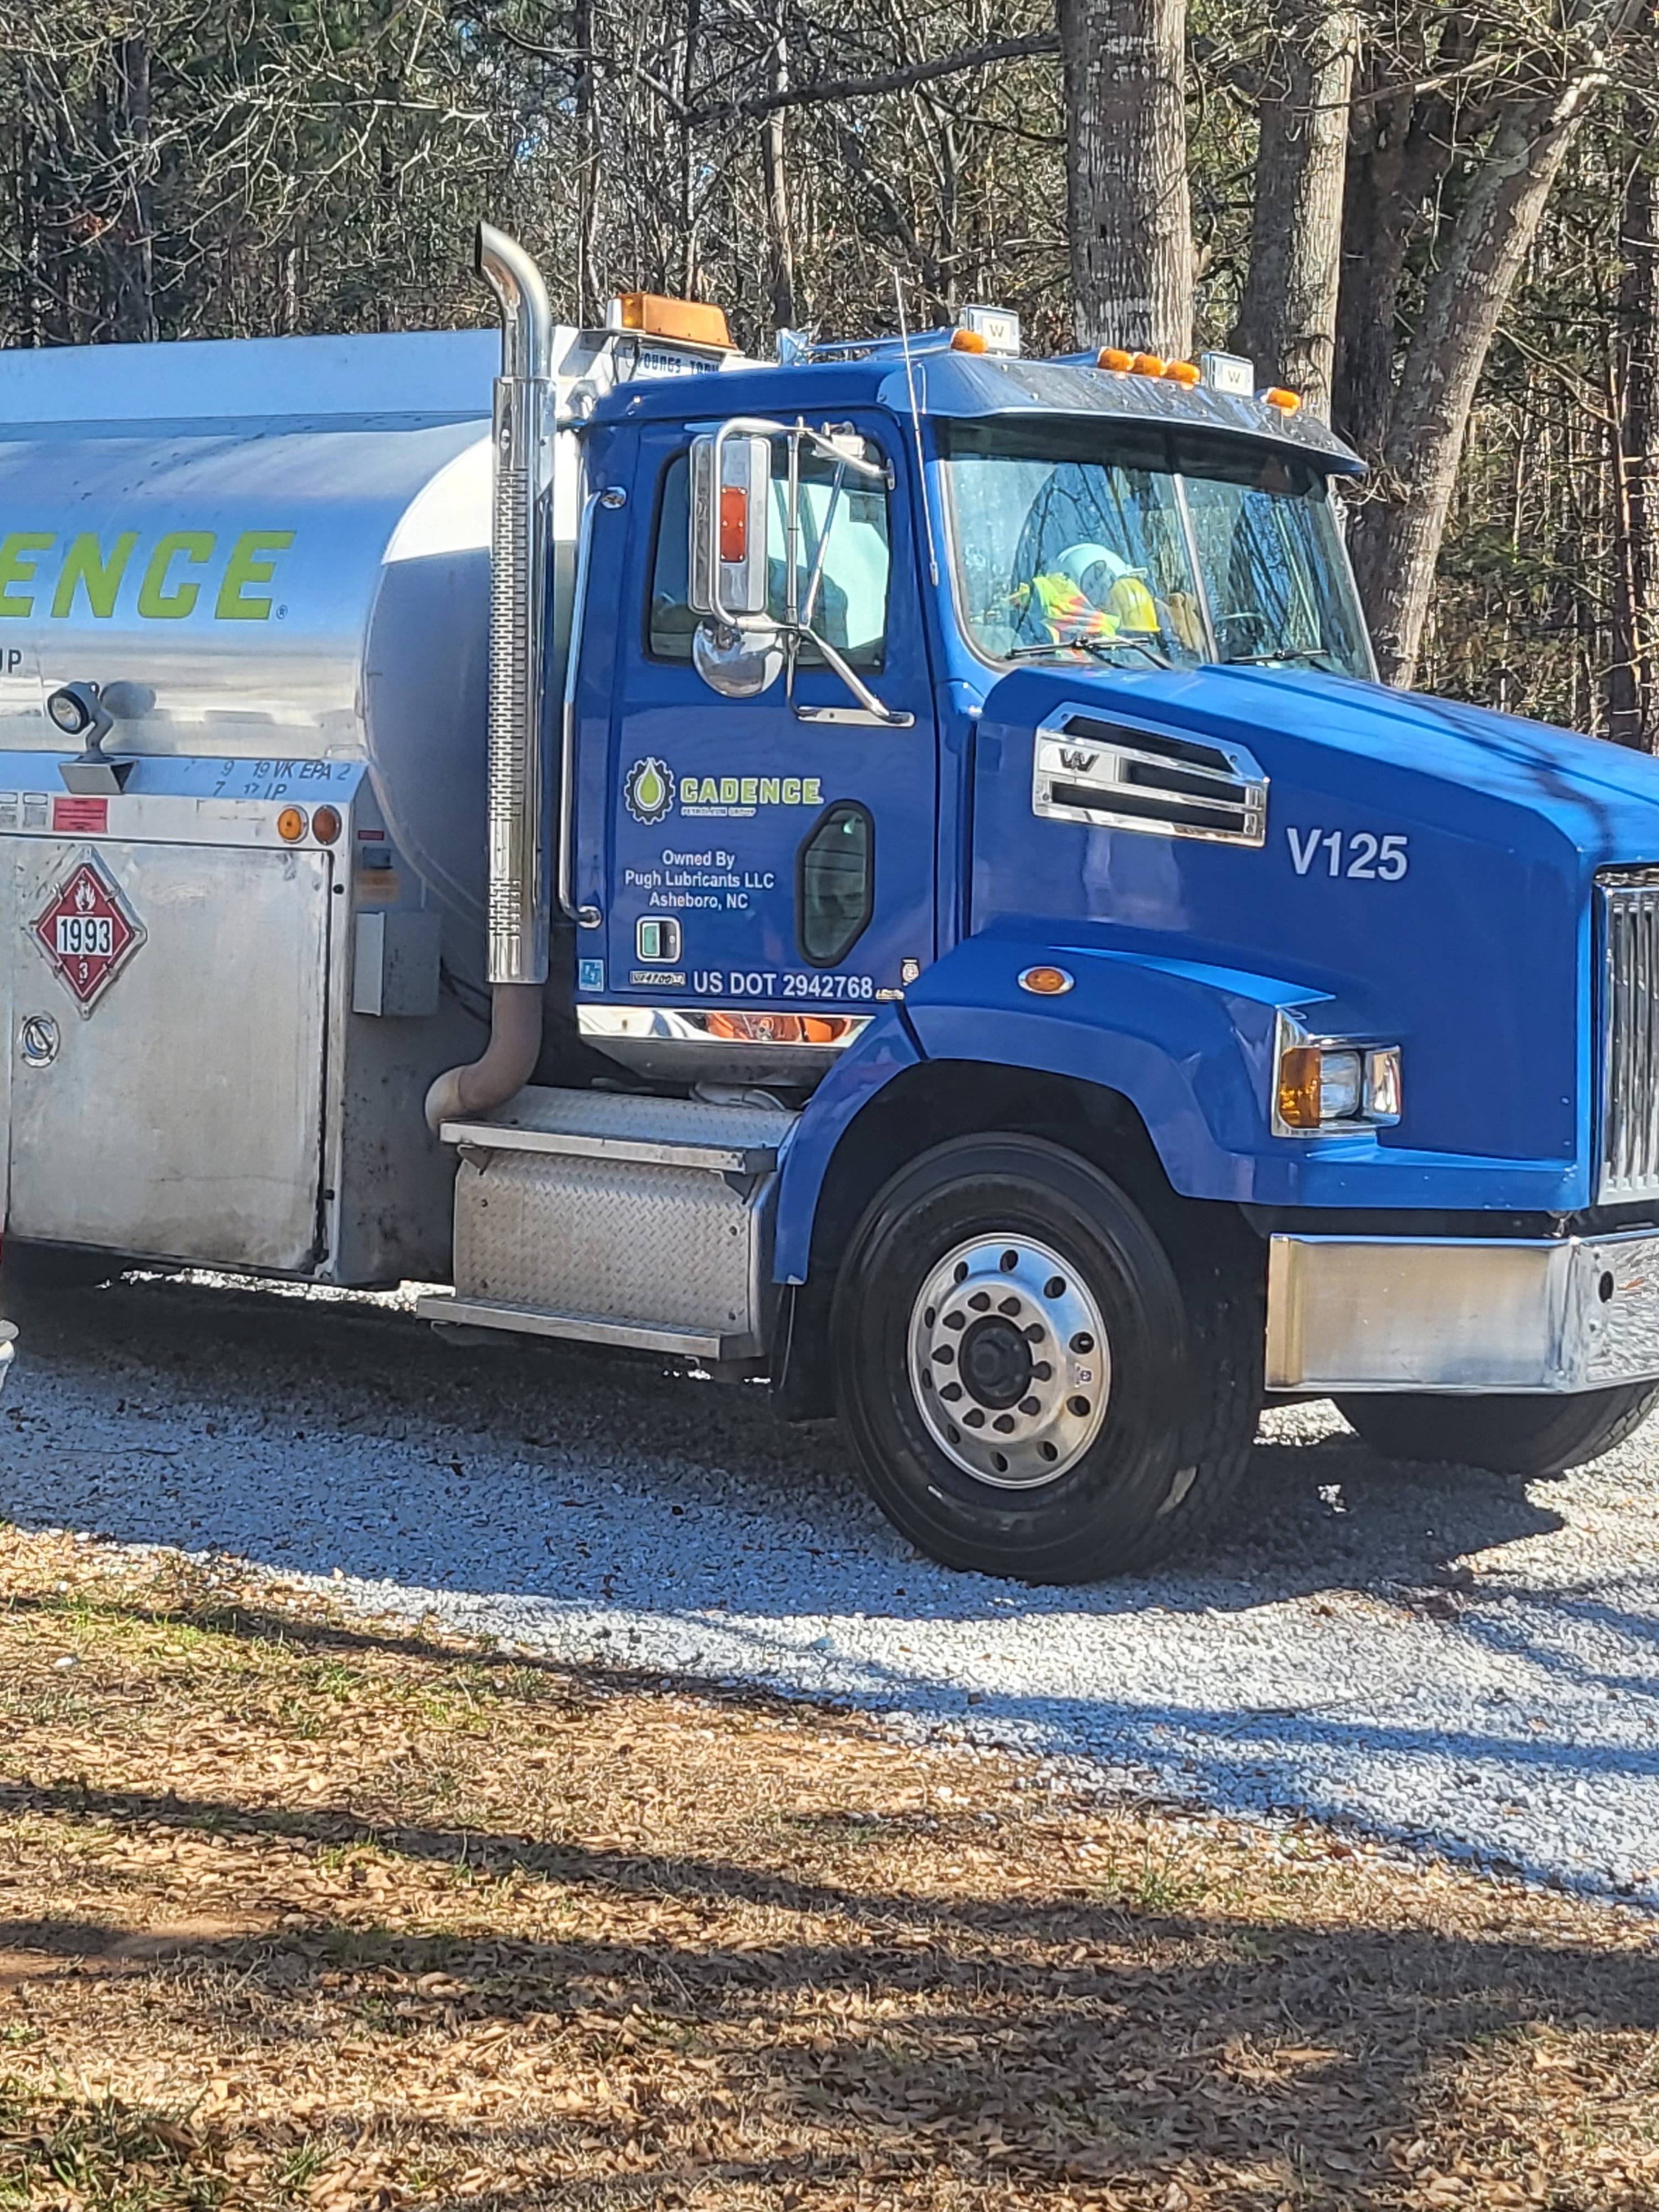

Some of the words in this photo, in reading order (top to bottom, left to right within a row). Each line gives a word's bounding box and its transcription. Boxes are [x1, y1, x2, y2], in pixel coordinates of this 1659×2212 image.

[0, 648, 22, 674] P
[299, 762, 332, 780] EPA
[680, 778, 822, 804] CADENCE
[662, 849, 711, 866] Owned
[716, 851, 735, 870] By
[1286, 828, 1408, 880] V125
[625, 870, 661, 889] Pugh
[665, 871, 740, 887] Lubricants
[745, 872, 774, 888] LLC
[649, 891, 722, 911] Asheboro,
[726, 893, 748, 909] NC
[61, 919, 110, 953] 1993
[693, 971, 723, 994] US
[731, 972, 776, 996] DOT
[783, 974, 873, 999] 2942768
